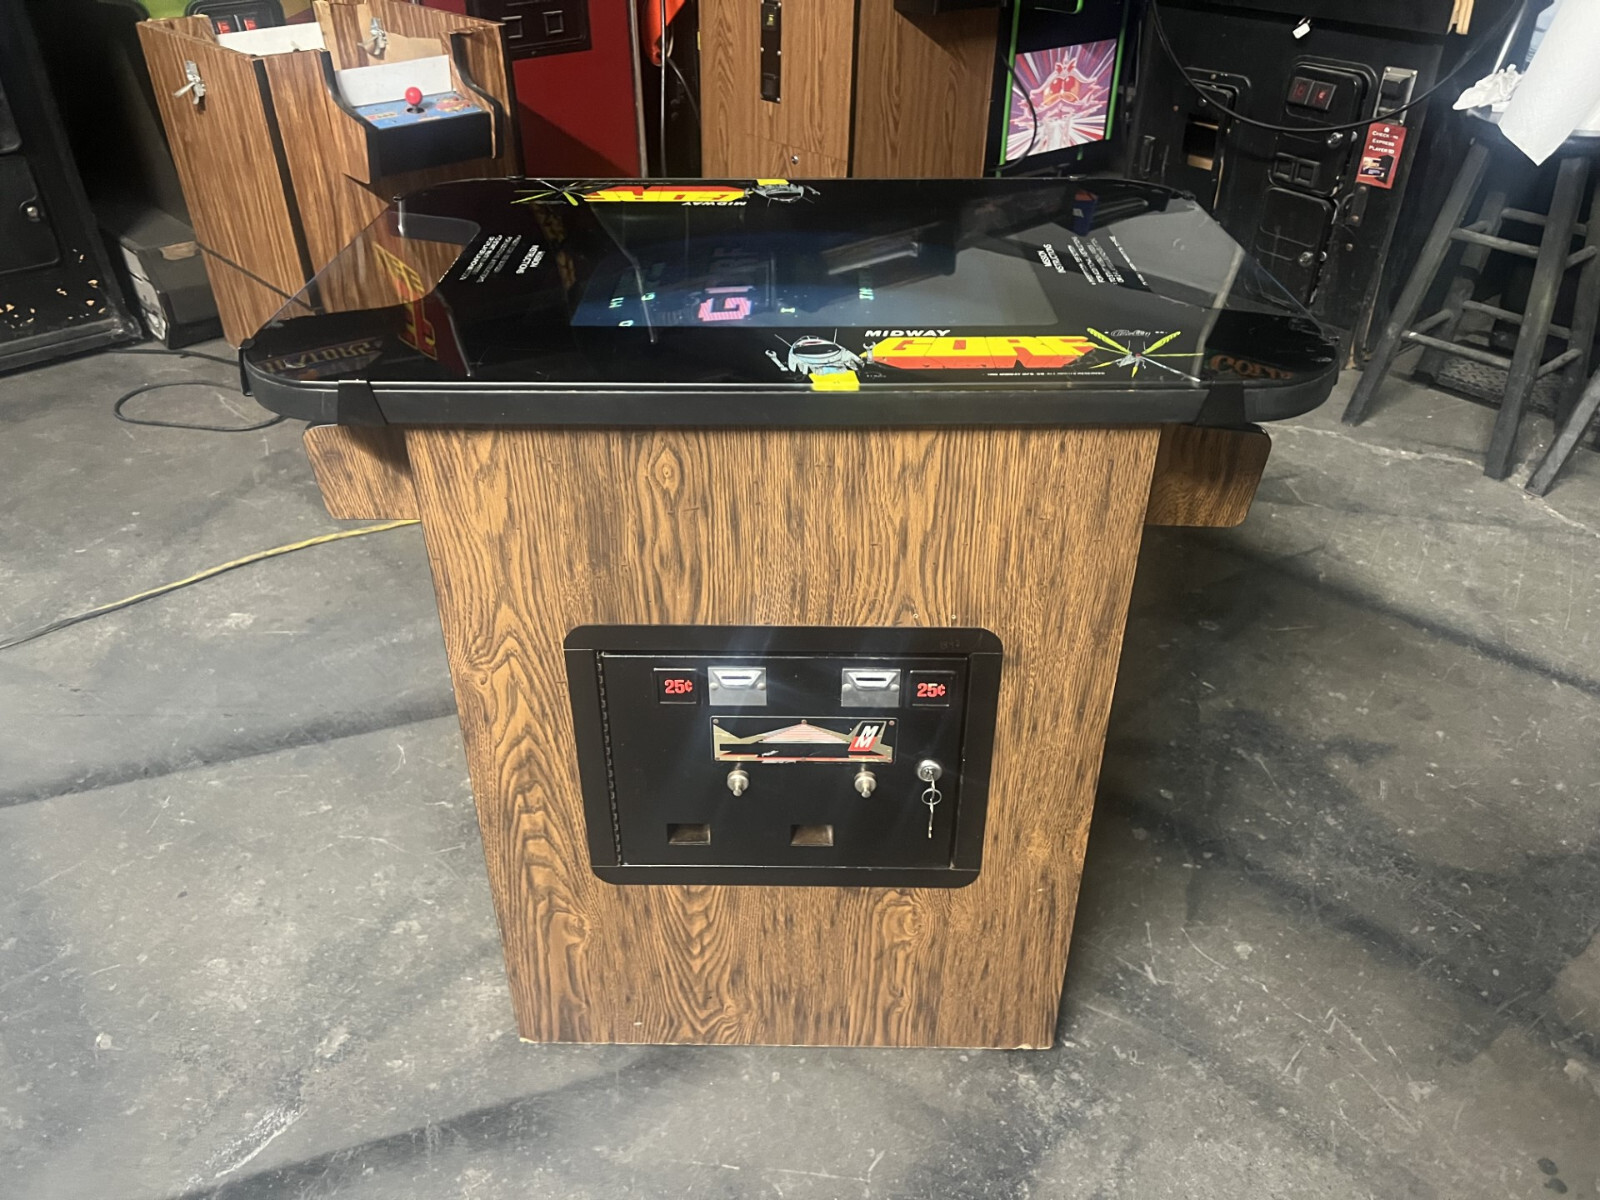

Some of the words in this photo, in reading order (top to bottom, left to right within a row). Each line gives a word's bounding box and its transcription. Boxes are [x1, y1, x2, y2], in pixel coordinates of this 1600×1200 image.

[864, 329, 951, 337] MIDWAY
[872, 335, 1095, 369] GORF
[664, 679, 693, 694] 25¢
[917, 682, 946, 698] 25¢
